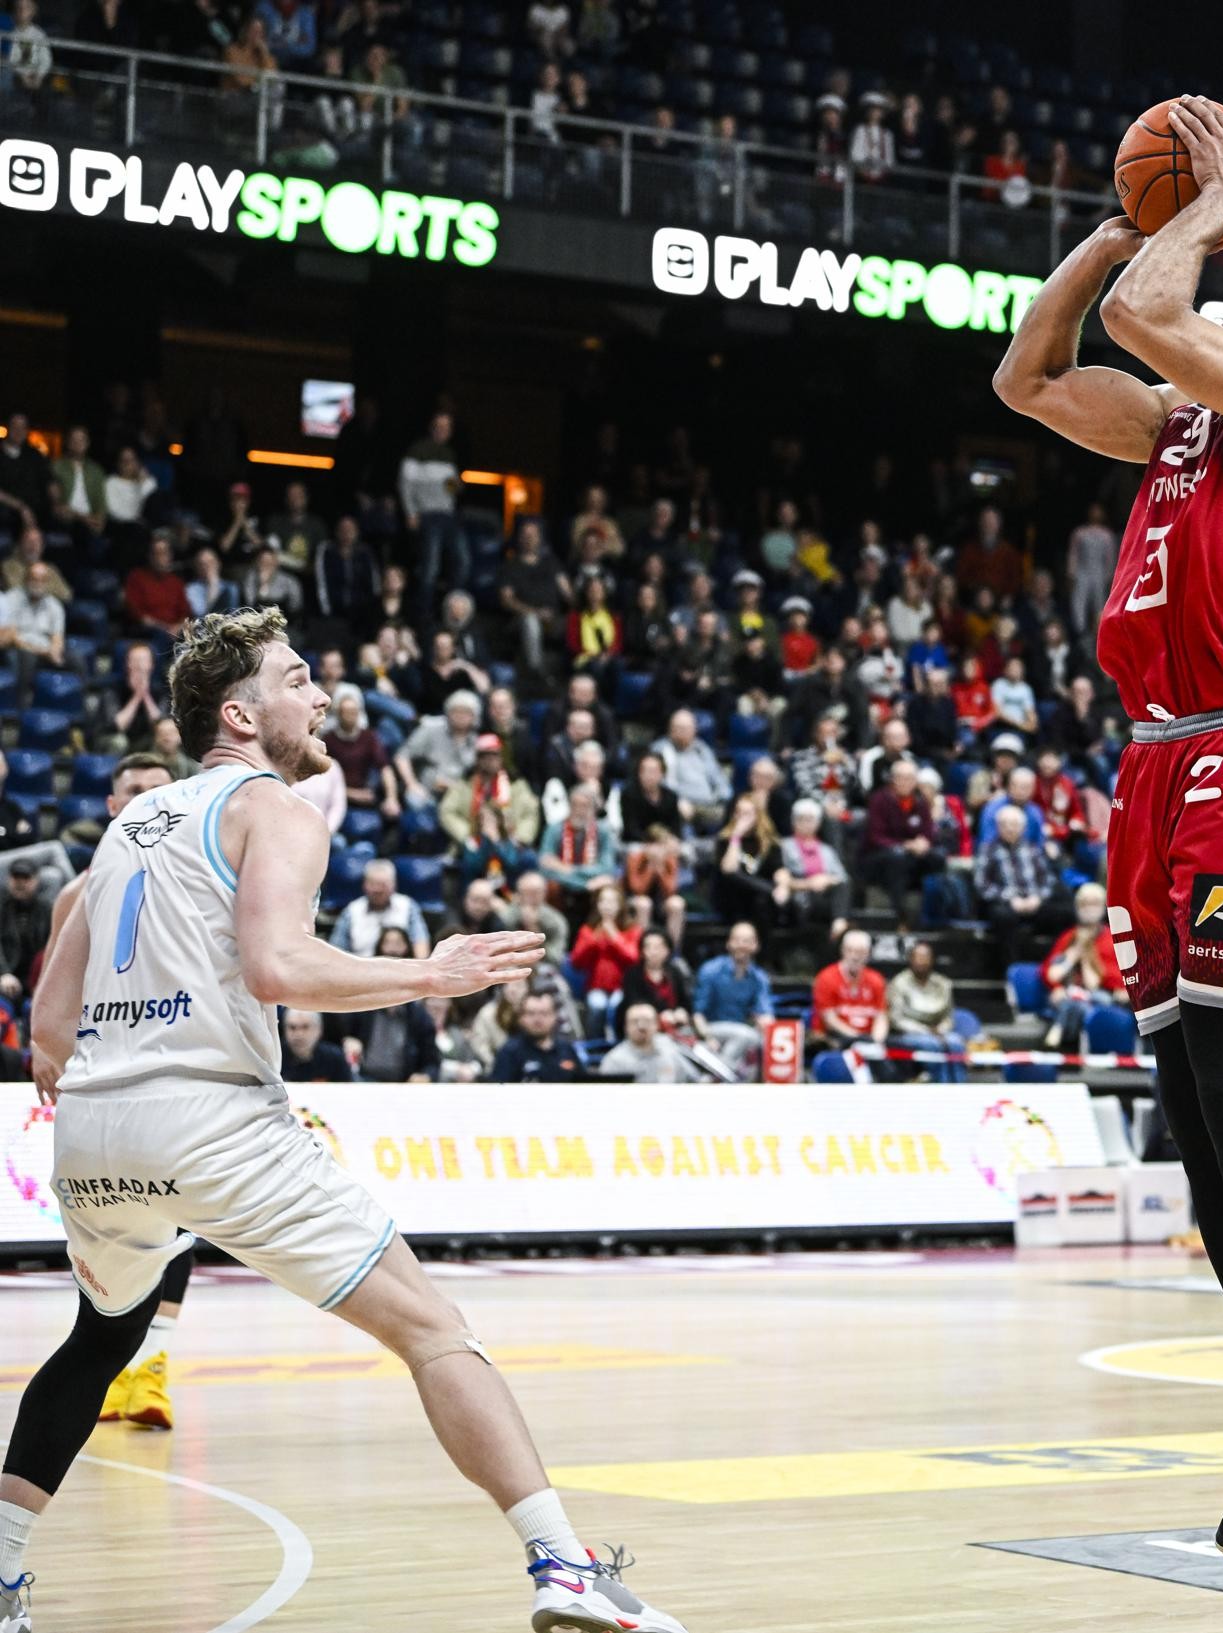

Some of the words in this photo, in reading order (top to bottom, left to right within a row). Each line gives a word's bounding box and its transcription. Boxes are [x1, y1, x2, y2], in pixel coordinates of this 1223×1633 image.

[93, 991, 192, 1029] amysoft
[770, 1026, 796, 1063] 5
[373, 1135, 463, 1180] ONE
[474, 1135, 595, 1179] TEAM
[612, 1134, 783, 1178] AGAINST
[799, 1133, 950, 1176] CANCER
